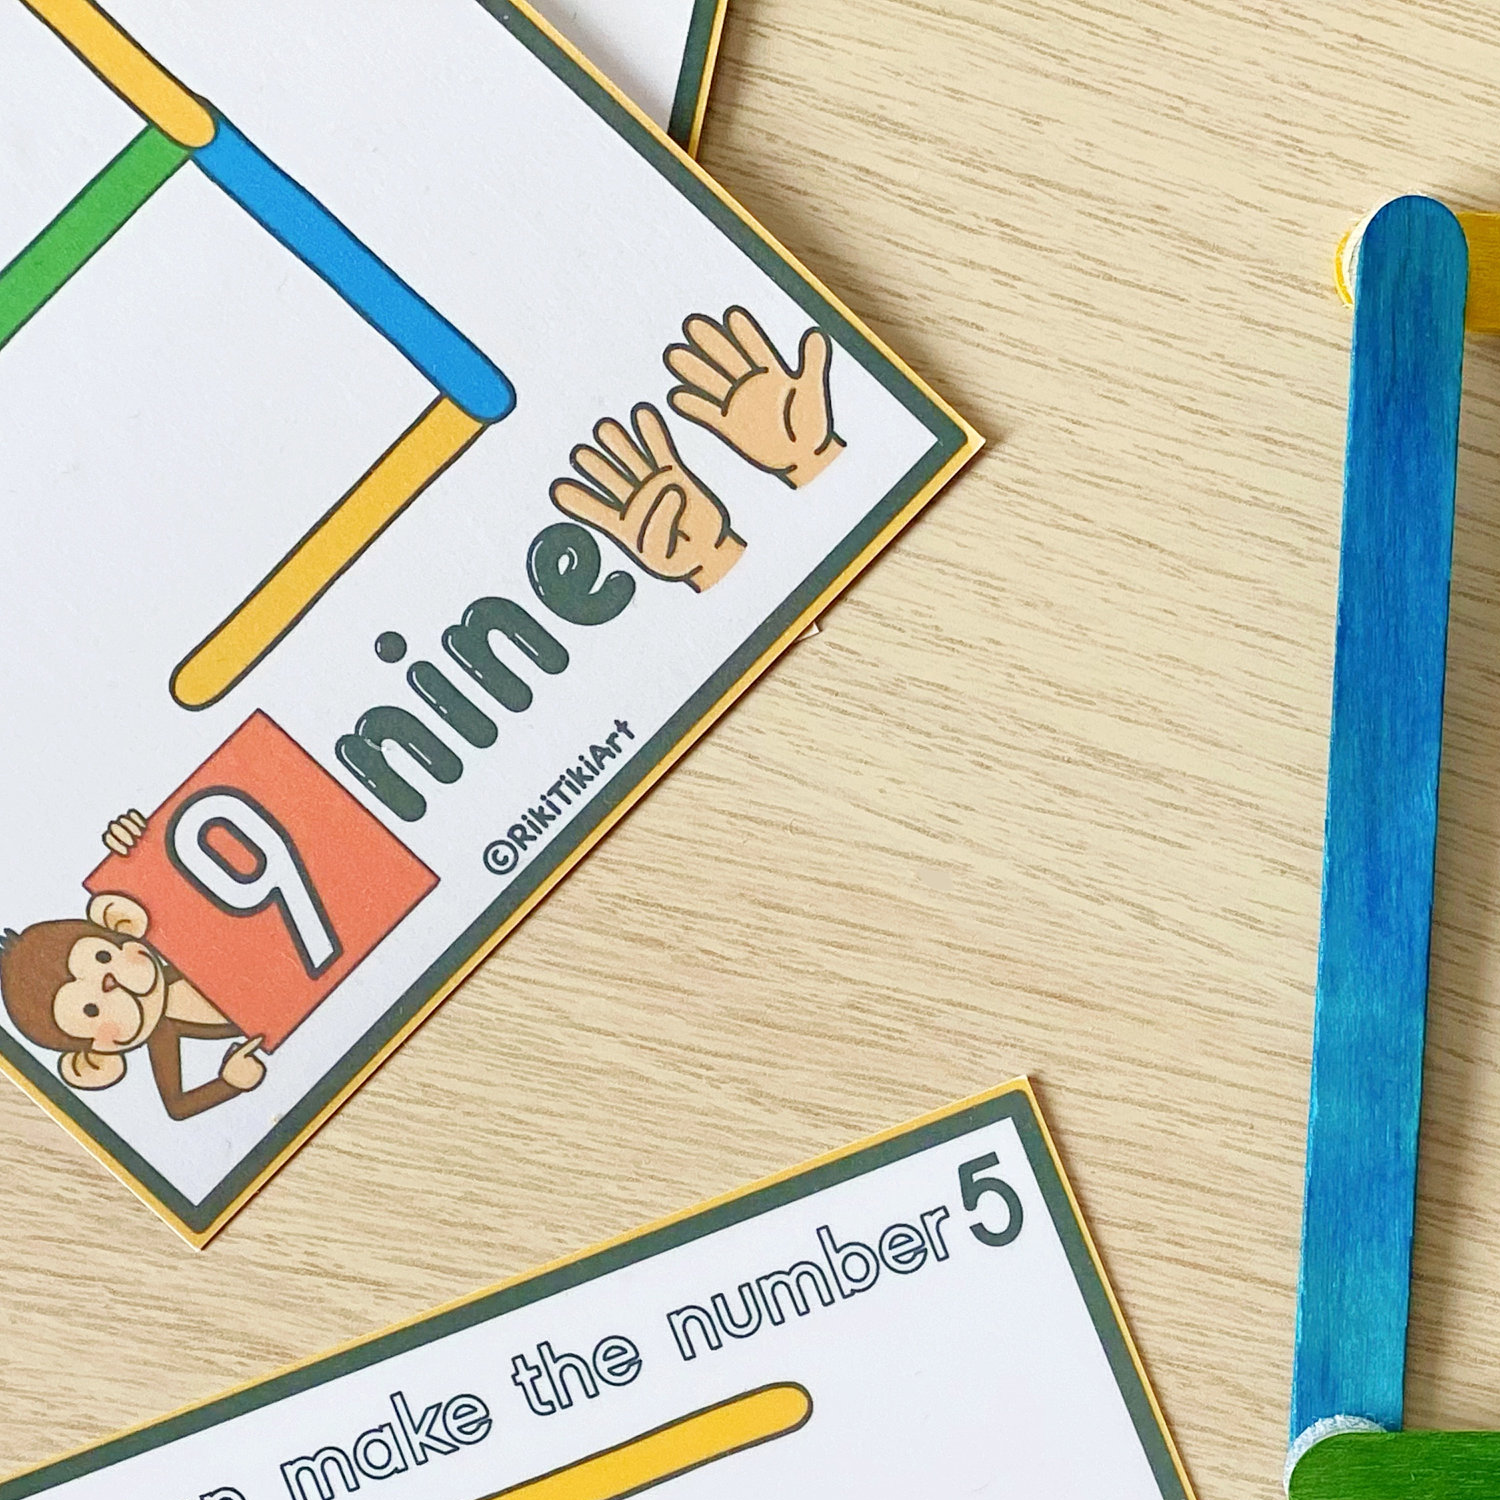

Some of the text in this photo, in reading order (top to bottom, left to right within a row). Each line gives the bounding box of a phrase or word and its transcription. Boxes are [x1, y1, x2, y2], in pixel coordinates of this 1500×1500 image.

[334, 522, 637, 823] nine
[164, 785, 345, 981] 9
[482, 719, 636, 876] ©RikiTikiArt
[510, 1334, 643, 1417] the
[666, 1205, 950, 1362] number
[957, 1151, 1024, 1247] 5
